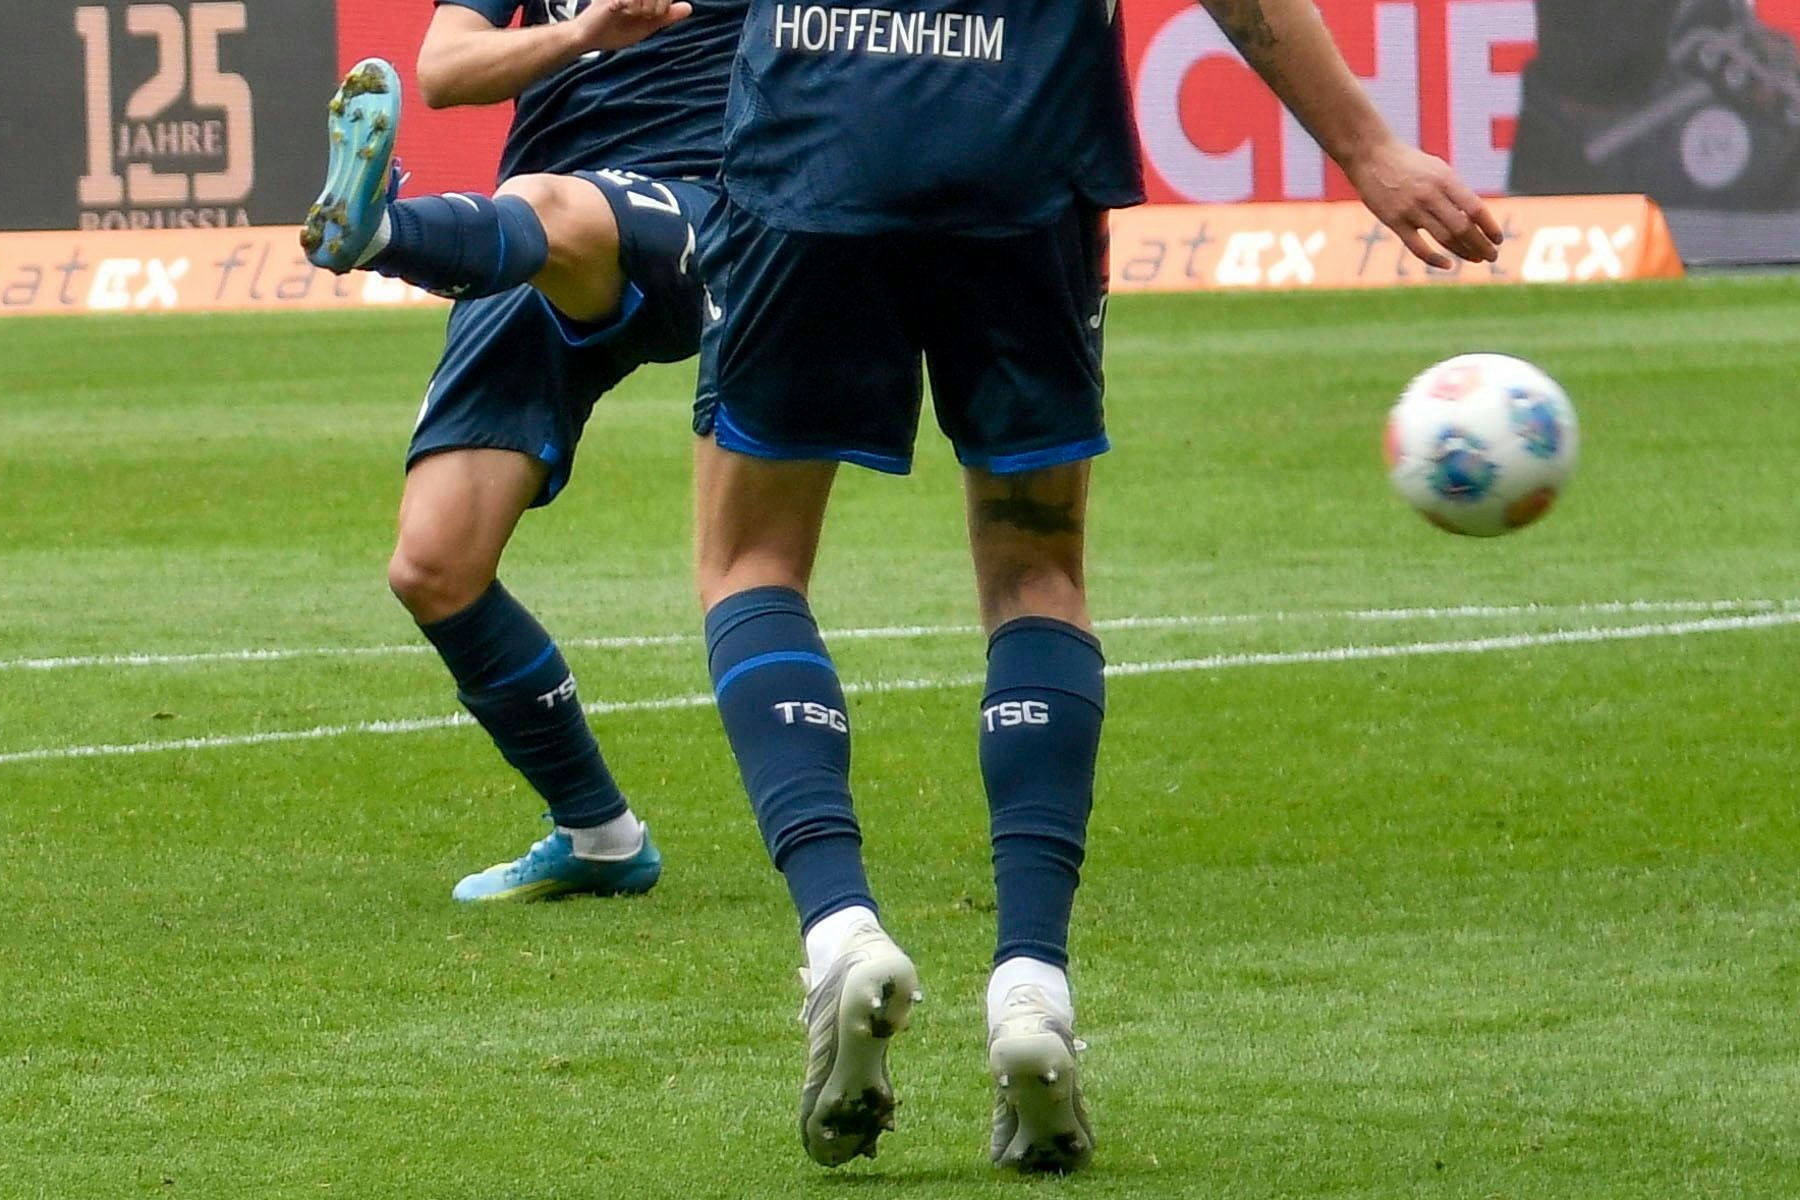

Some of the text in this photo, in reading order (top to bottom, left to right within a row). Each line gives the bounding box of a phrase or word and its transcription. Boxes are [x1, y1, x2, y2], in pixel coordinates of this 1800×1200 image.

[774, 4, 1006, 61] HOFFENHEIM
[74, 1, 256, 204] 125
[116, 120, 224, 156] JAHRE
[536, 669, 578, 709] TS
[774, 700, 849, 734] TSG
[982, 699, 1049, 733] TSG
